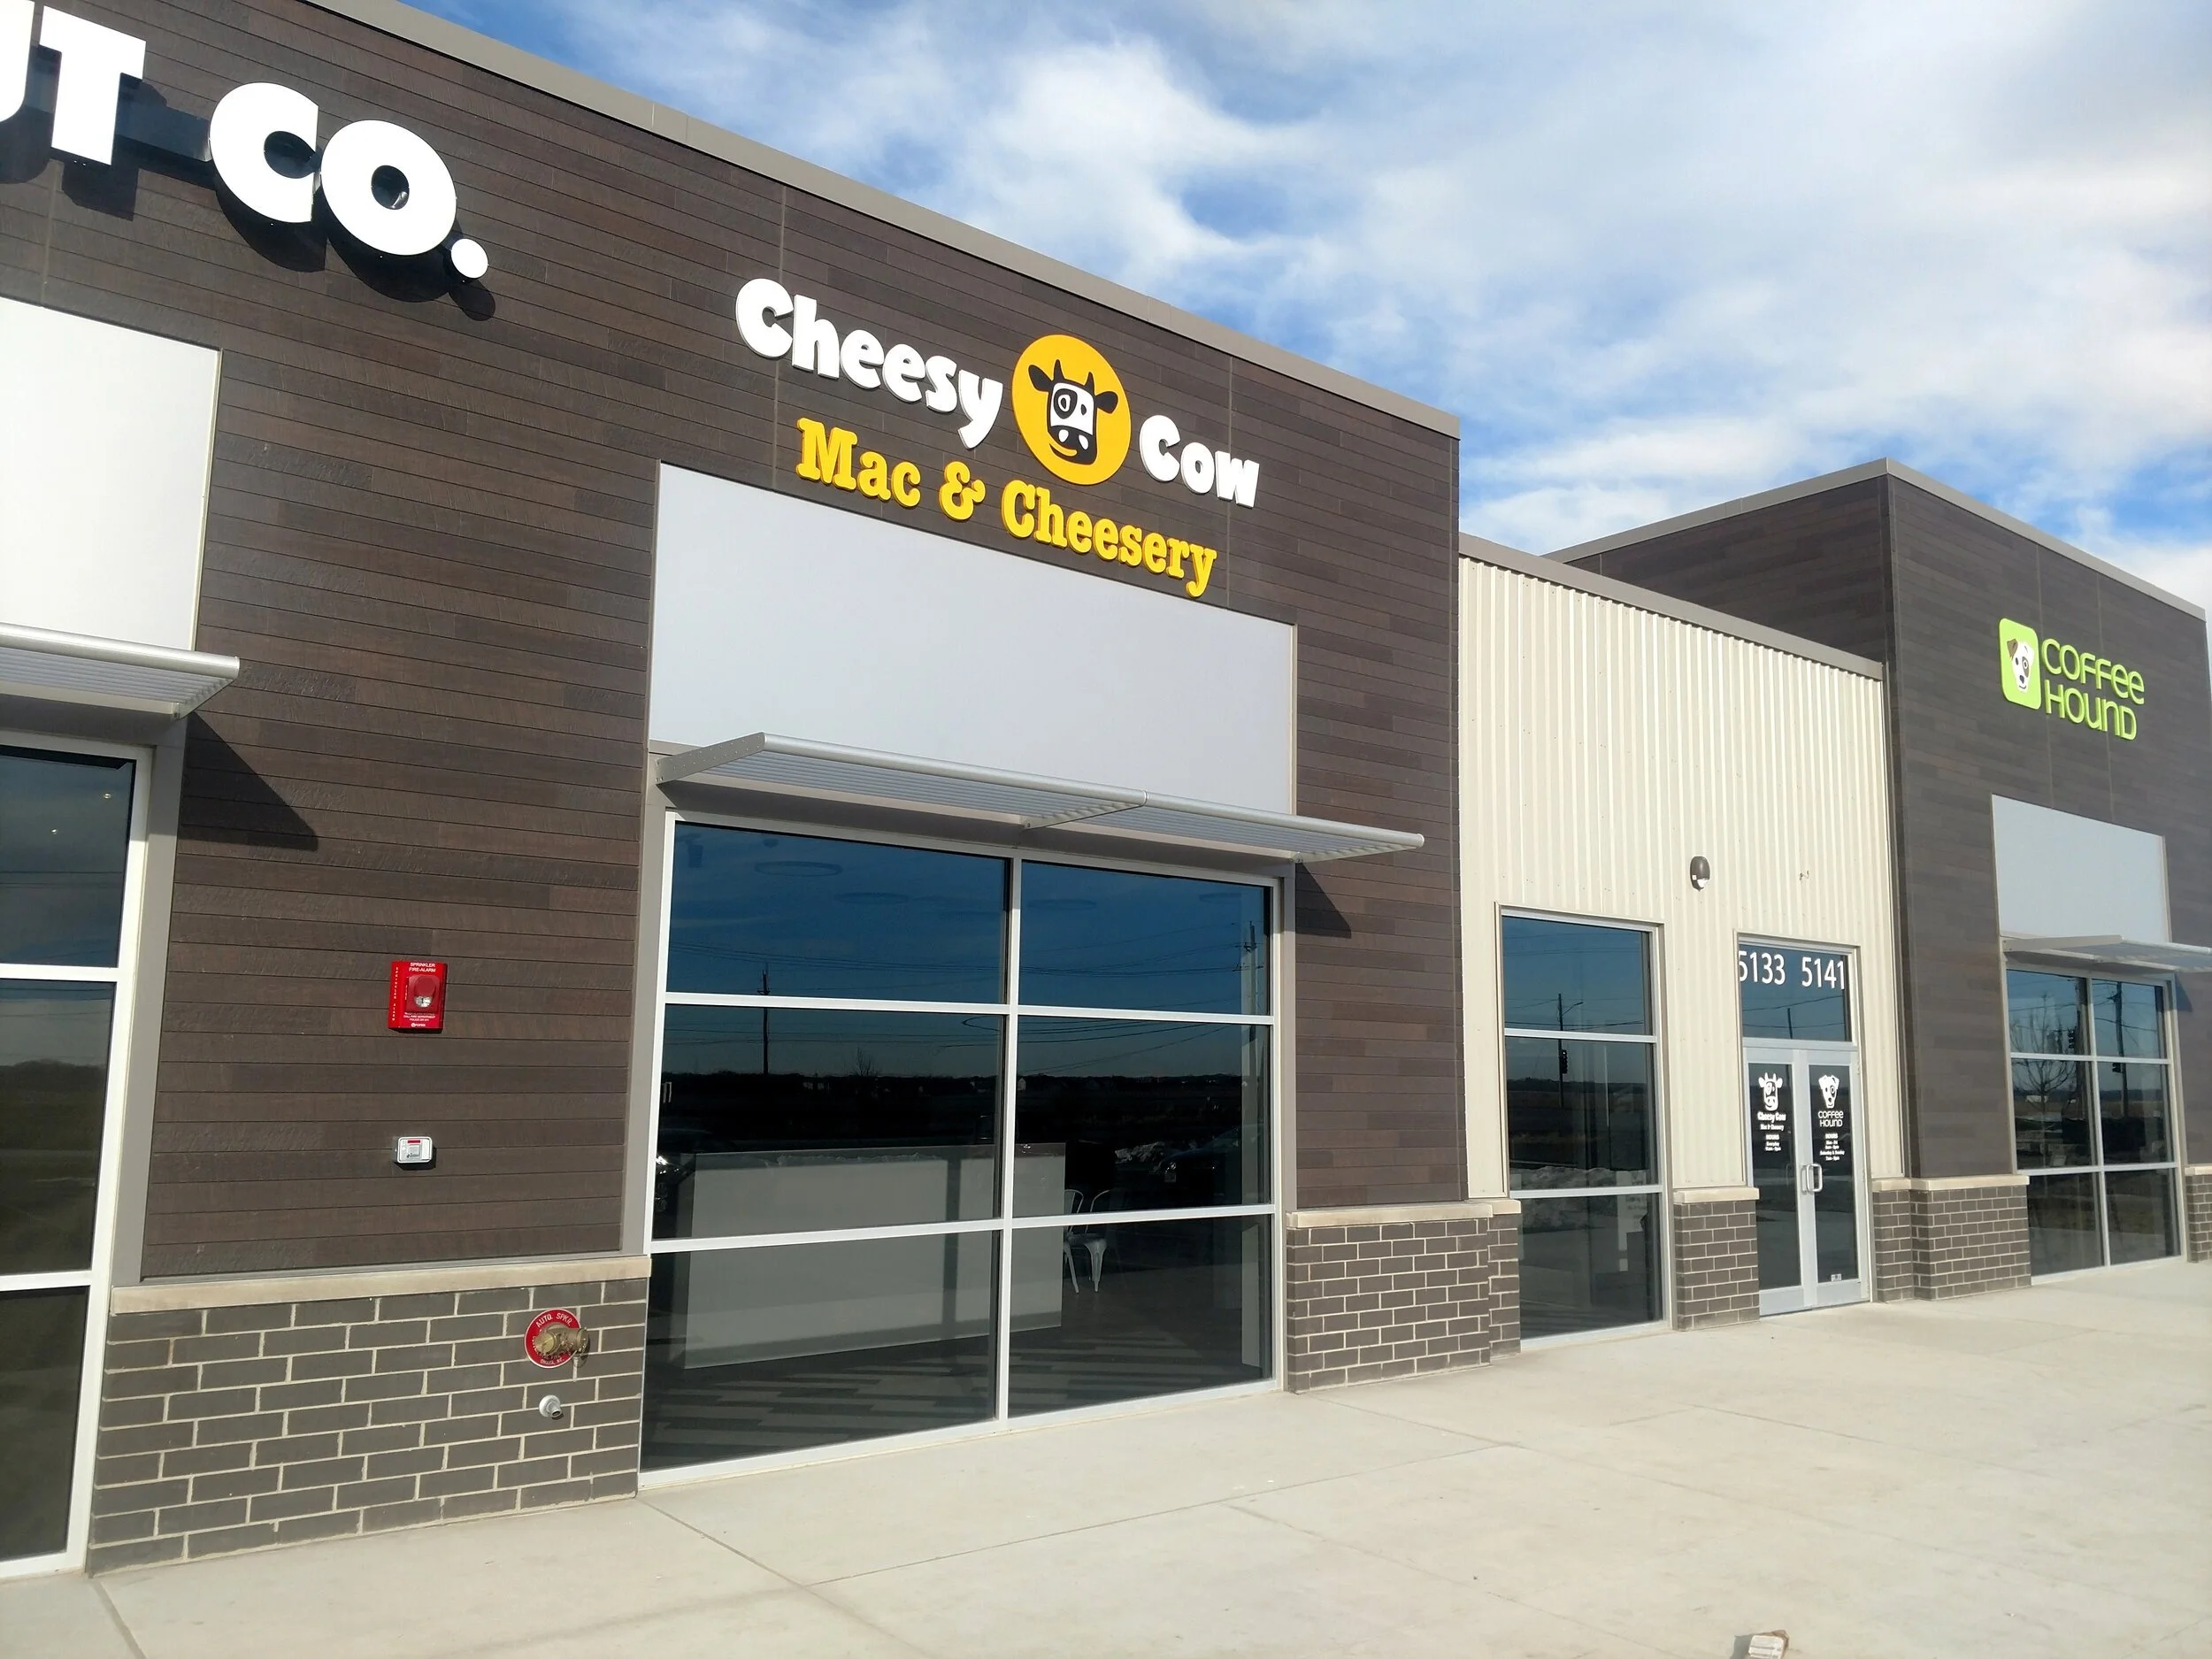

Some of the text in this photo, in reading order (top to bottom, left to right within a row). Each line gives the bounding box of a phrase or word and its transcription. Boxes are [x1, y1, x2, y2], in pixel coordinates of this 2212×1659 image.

[209, 82, 488, 279] CO.
[735, 278, 1260, 509] Cheesy Cow
[796, 418, 1217, 598] Mac & Cheesery
[1739, 950, 1845, 990] 5133 5141
